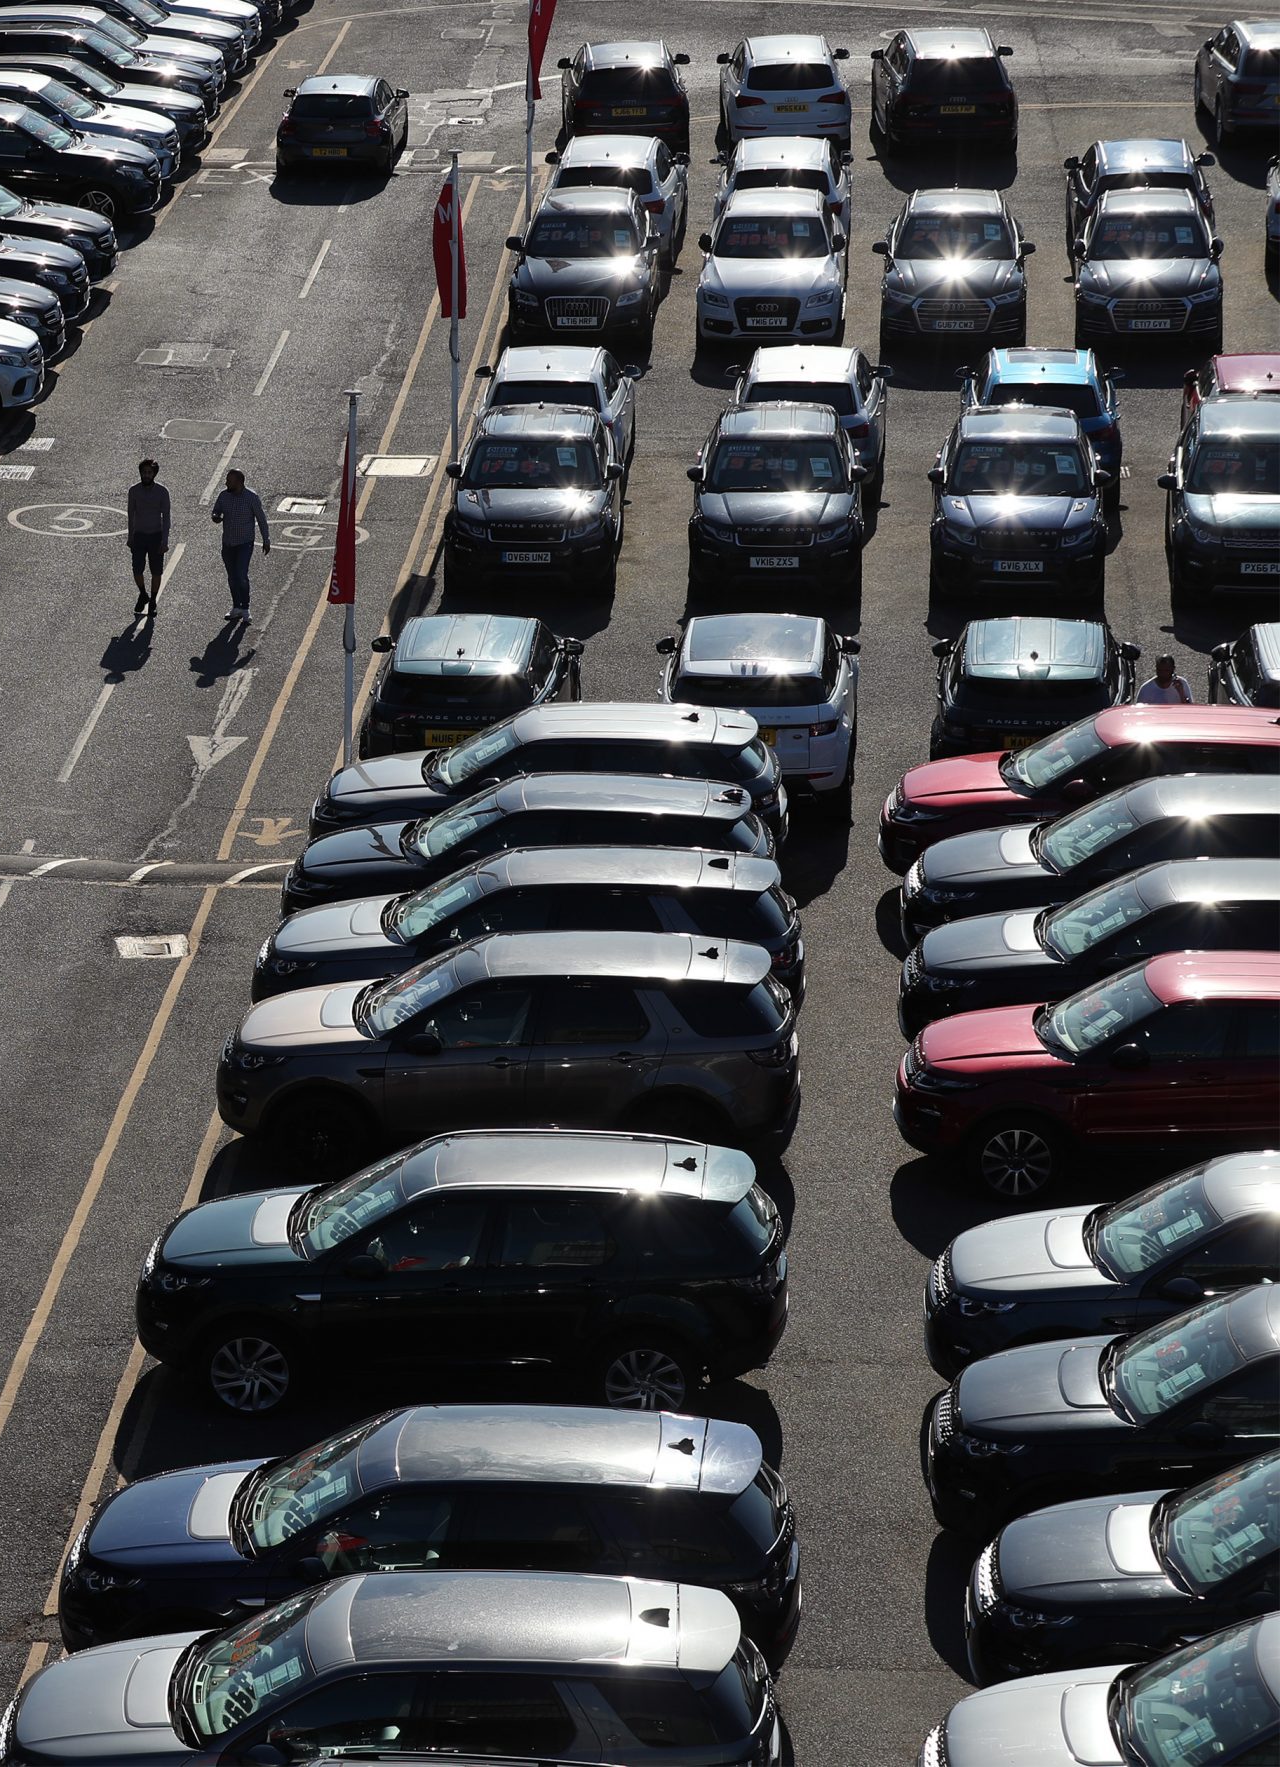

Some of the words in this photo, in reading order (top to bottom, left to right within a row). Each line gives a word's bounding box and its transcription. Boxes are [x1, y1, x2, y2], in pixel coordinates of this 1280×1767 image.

[561, 317, 577, 325] LT16
[50, 508, 101, 532] 5
[507, 553, 530, 562] OV66
[532, 553, 549, 562] UNZ
[755, 557, 775, 566] VK16
[776, 557, 794, 566] ZXS
[1000, 561, 1021, 571] GV16
[1022, 561, 1041, 571] XLX
[1244, 563, 1268, 572] PX66
[431, 735, 454, 743] NU16
